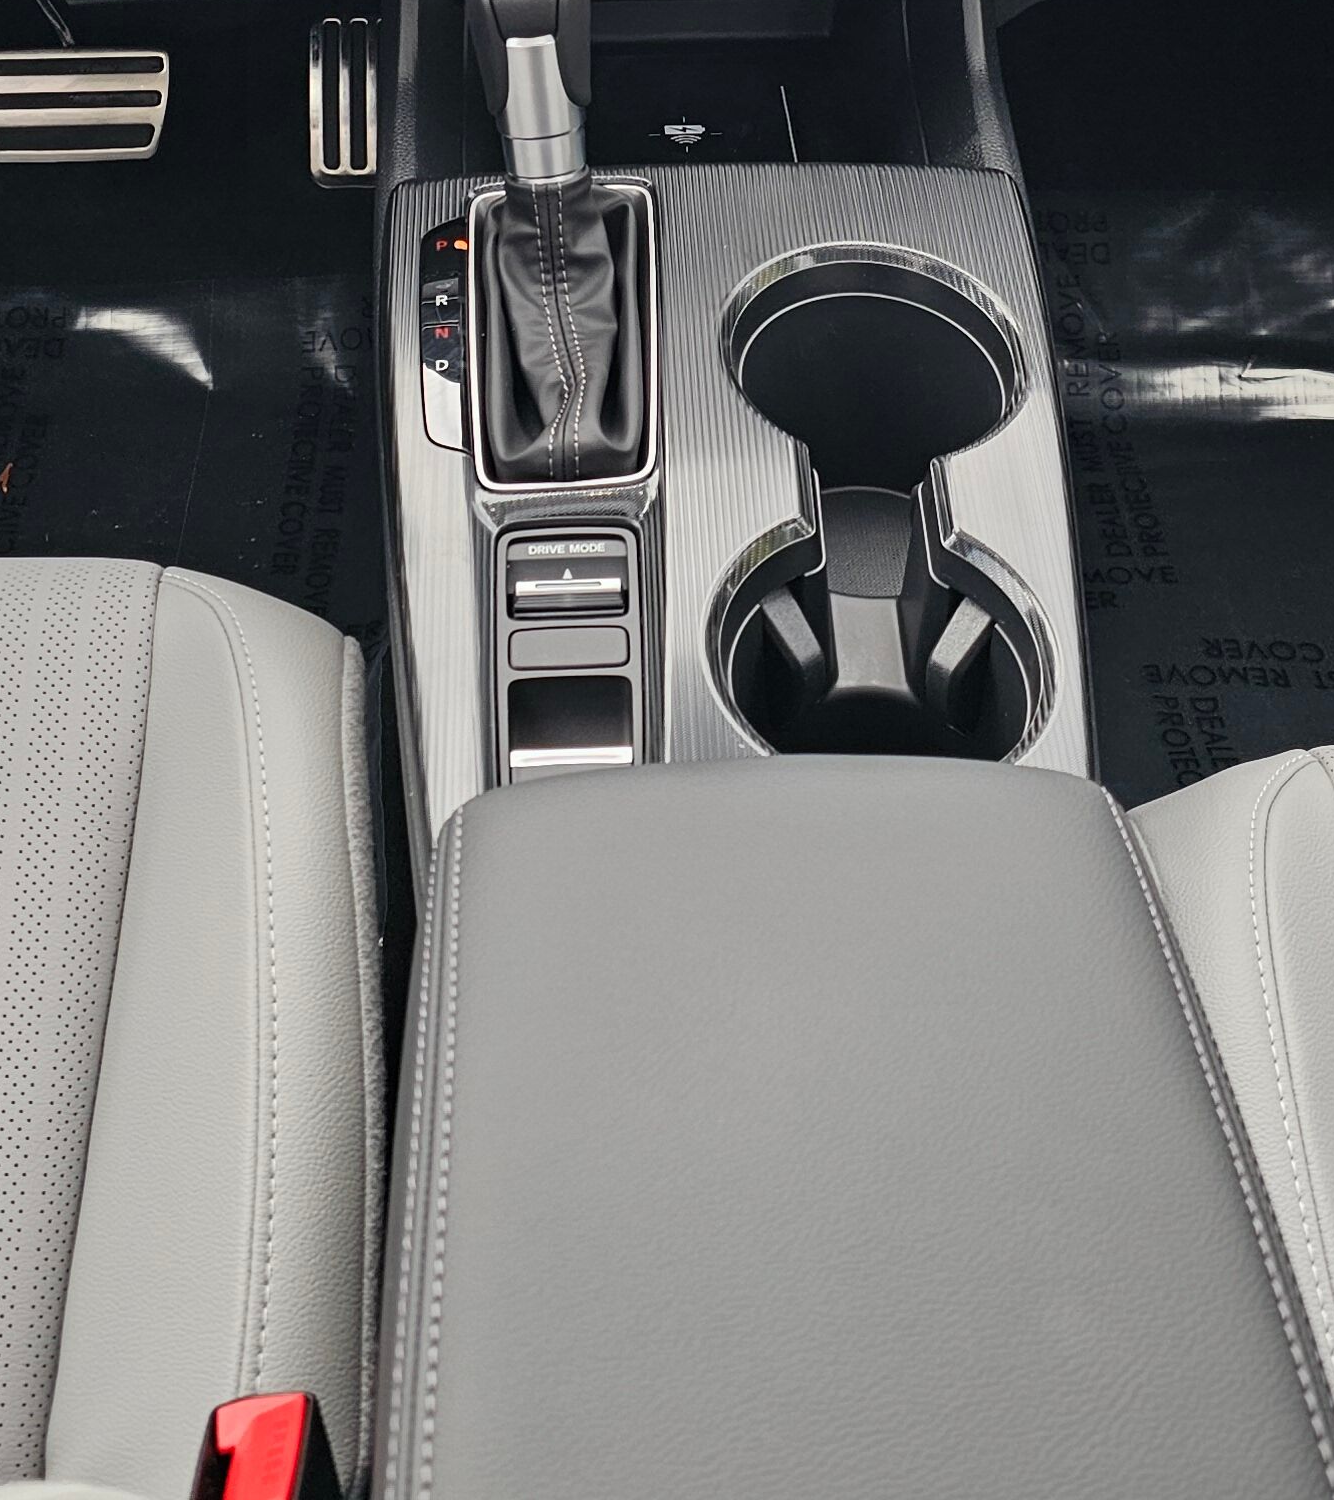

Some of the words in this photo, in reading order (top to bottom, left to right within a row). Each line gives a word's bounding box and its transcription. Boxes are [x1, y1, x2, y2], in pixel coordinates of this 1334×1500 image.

[436, 241, 447, 251] P
[435, 295, 448, 306] R
[435, 328, 449, 339] N
[435, 360, 449, 371] D
[270, 501, 307, 577] COVER
[528, 544, 565, 556] DRIVE
[569, 542, 606, 554] MODE
[1199, 636, 1325, 663] COVER
[1139, 662, 1292, 690] REMOVE
